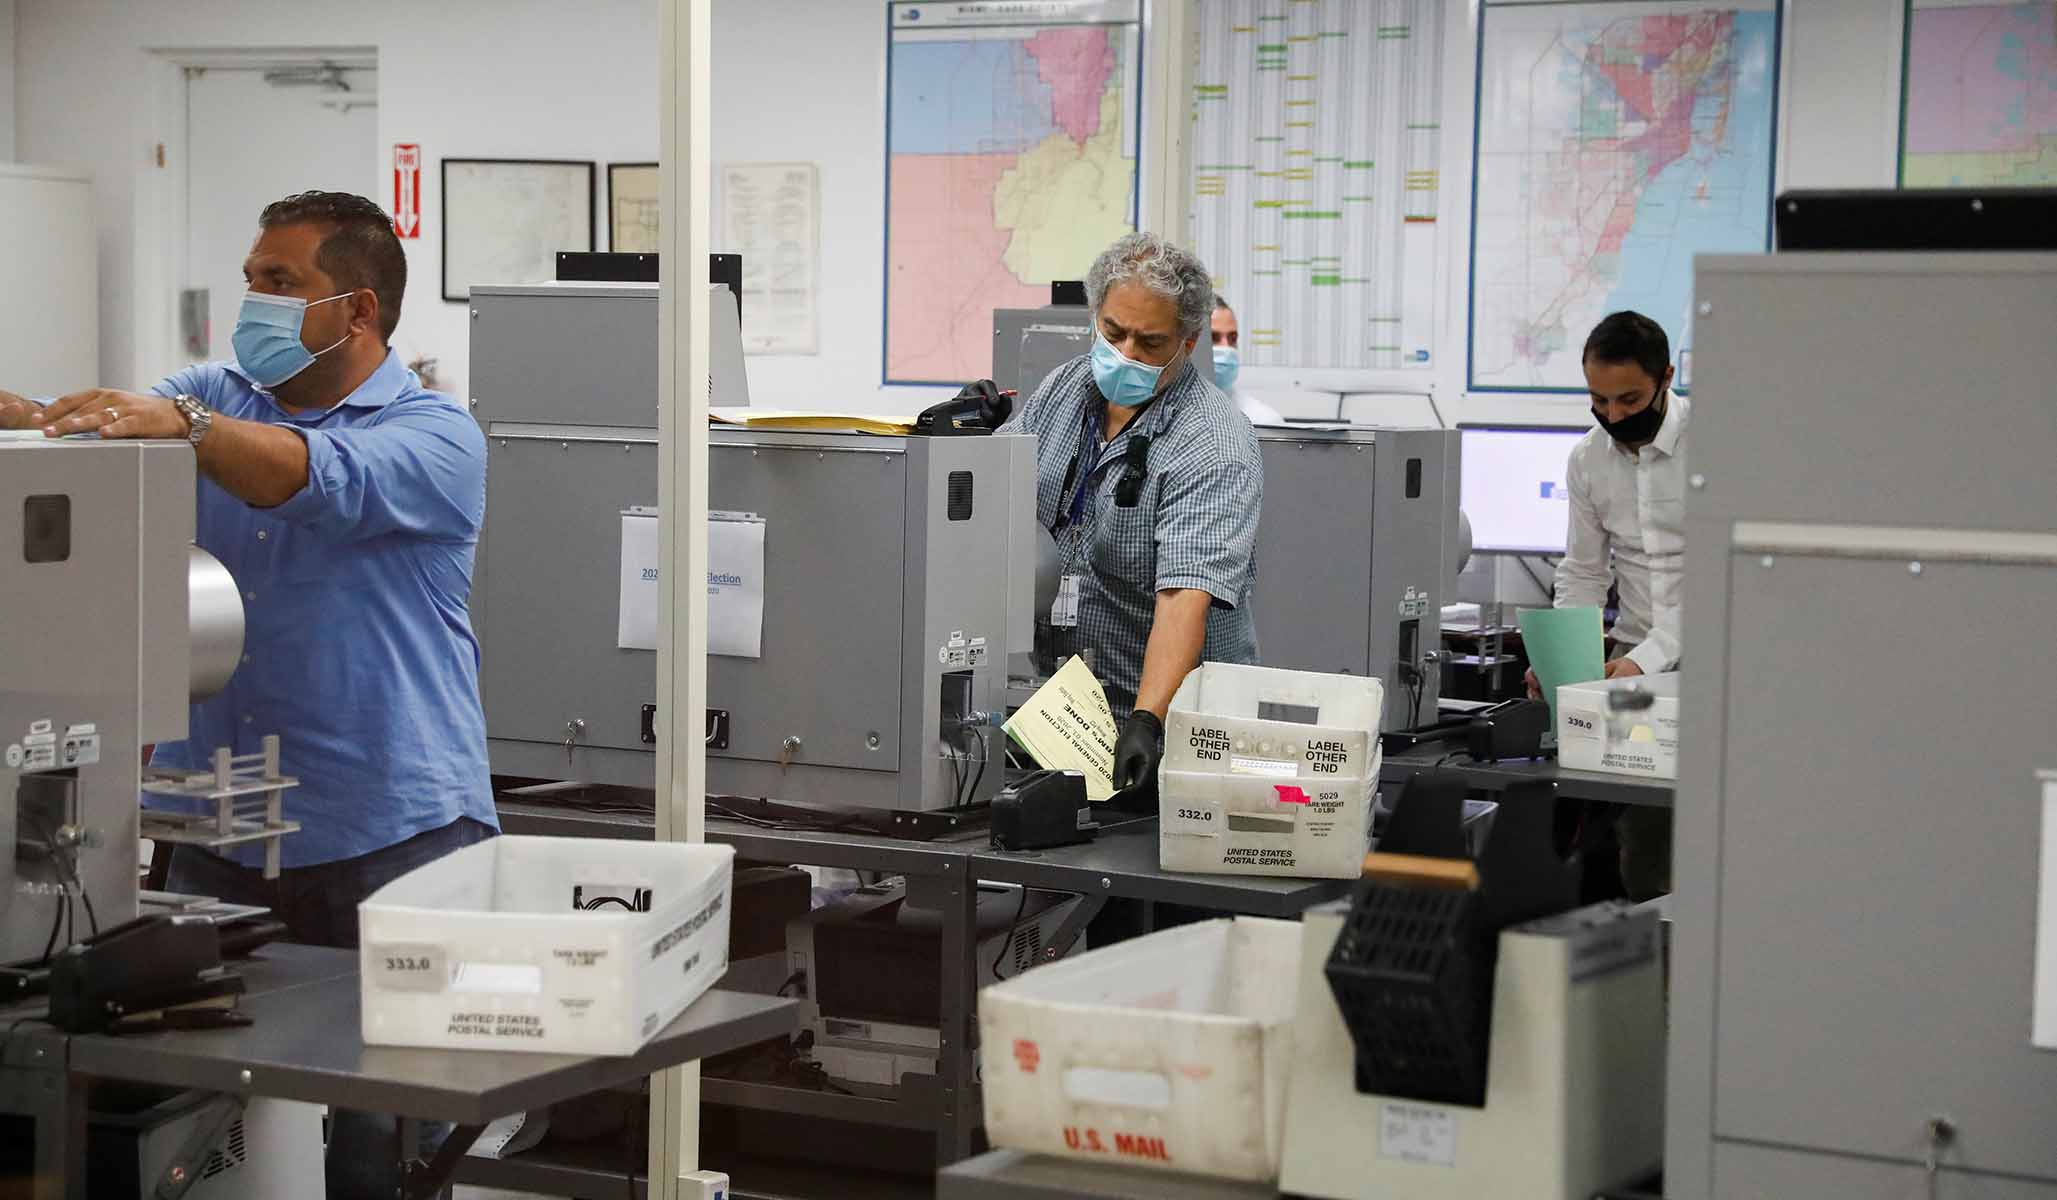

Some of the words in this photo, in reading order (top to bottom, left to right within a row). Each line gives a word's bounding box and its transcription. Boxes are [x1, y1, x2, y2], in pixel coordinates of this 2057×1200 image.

[642, 568, 658, 578] 202
[1063, 704, 1089, 730] DONE
[1040, 709, 1071, 739] ELECTION
[1191, 727, 1230, 741] LABEL
[1189, 738, 1231, 751] OTHER
[1307, 740, 1347, 753] LABEL
[1070, 738, 1098, 766] GENERAL
[1196, 749, 1222, 761] END
[1305, 751, 1347, 763] OTHER
[1603, 753, 1627, 762] UNITED
[1628, 755, 1654, 764] STATES
[1312, 762, 1338, 774] END
[1319, 792, 1339, 800] 5029
[1178, 809, 1212, 821] 332.0
[1226, 848, 1258, 857] UNITED
[1259, 849, 1293, 858] STATES
[1223, 857, 1257, 866] POSTAL
[1258, 858, 1296, 867] SERVICE
[451, 1013, 495, 1025] UNITED
[496, 1014, 541, 1026] STATES
[447, 1024, 491, 1036] POSTAL
[495, 1026, 545, 1038] SERVICE
[1063, 1126, 1109, 1152] U.S.
[1113, 1132, 1170, 1161] MAIL
